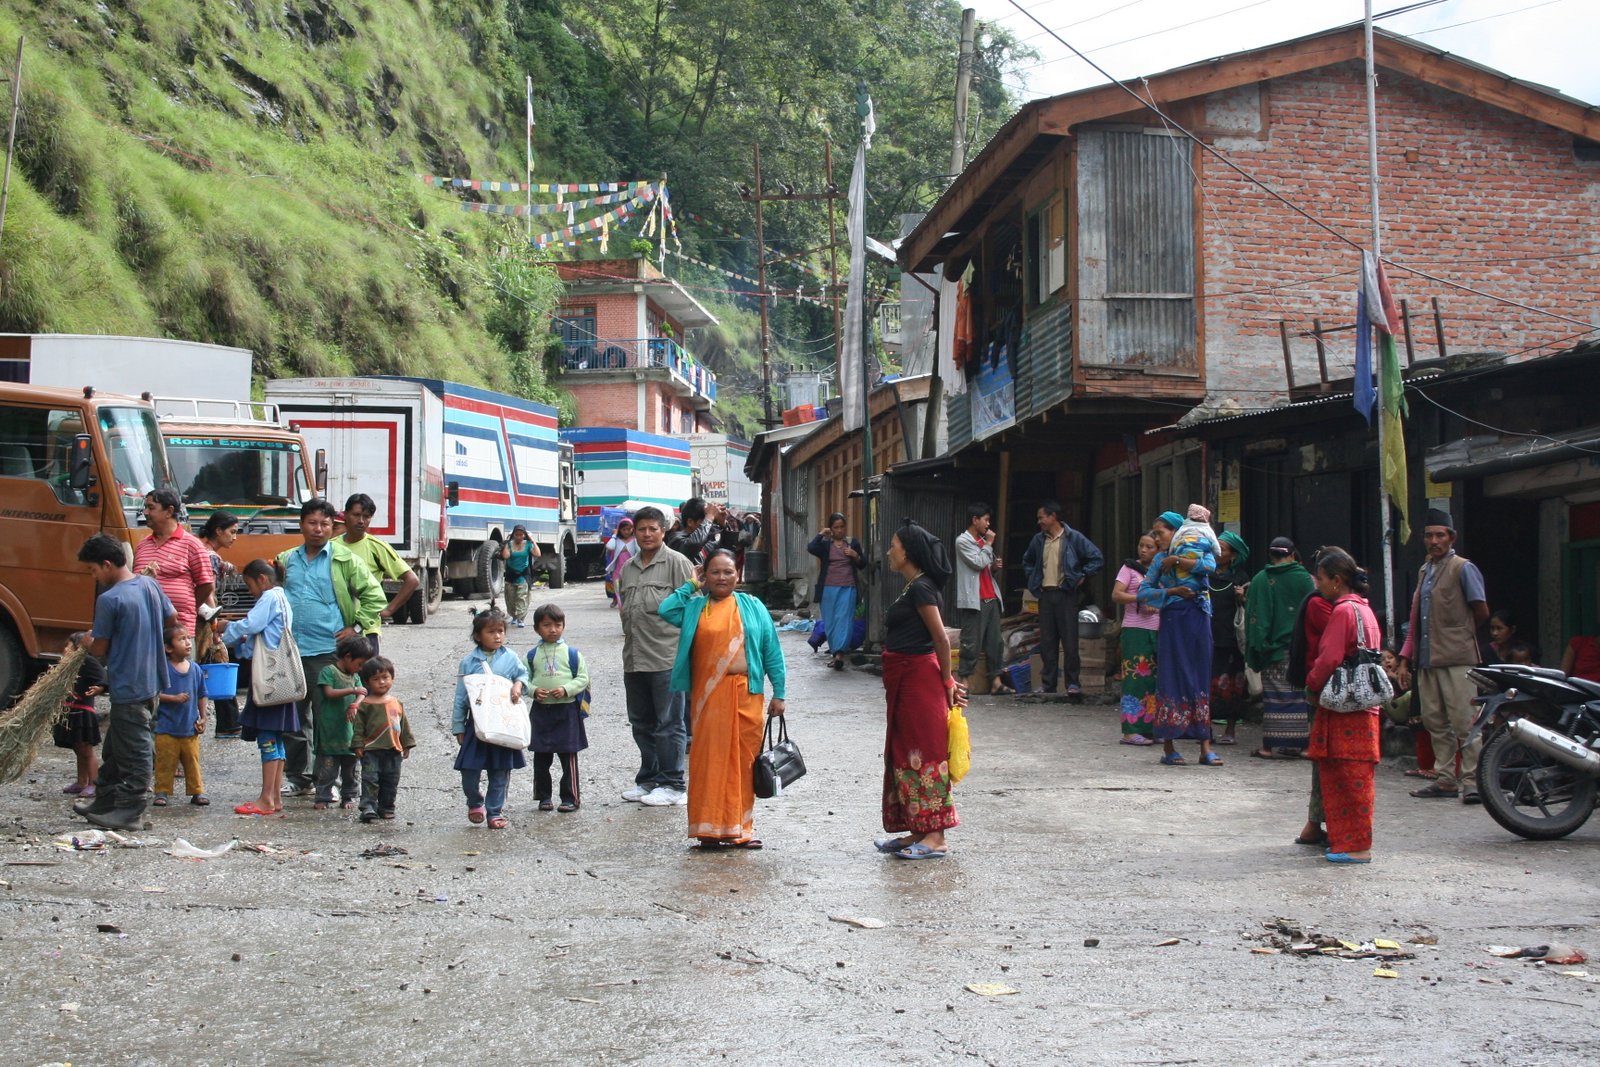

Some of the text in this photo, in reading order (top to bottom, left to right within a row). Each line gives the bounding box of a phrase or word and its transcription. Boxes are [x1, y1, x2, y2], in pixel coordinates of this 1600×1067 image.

[169, 437, 283, 448] Road Express
[1, 509, 66, 521] INTERCOOLER
